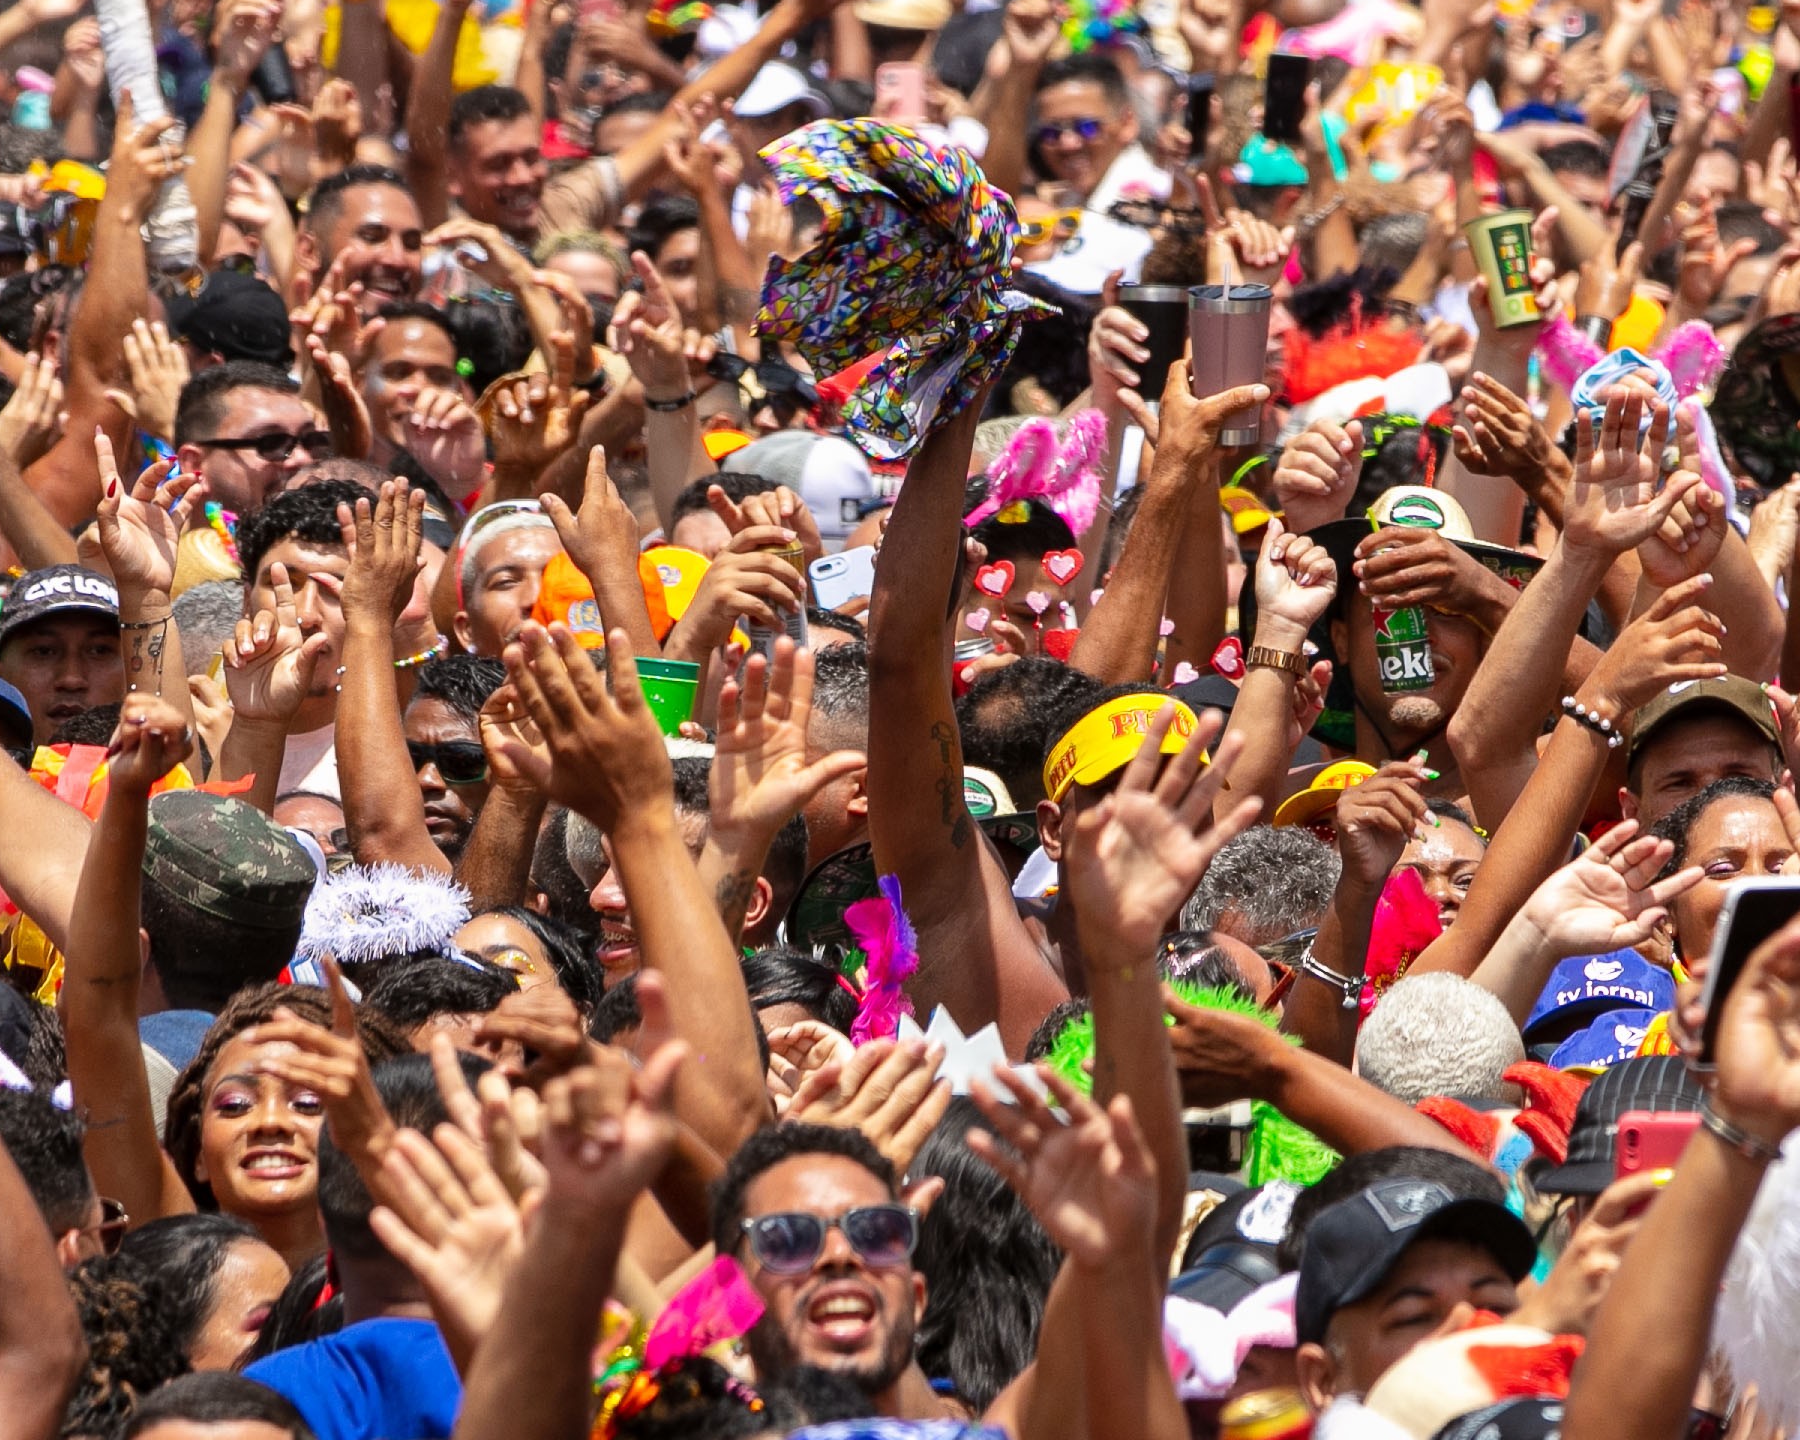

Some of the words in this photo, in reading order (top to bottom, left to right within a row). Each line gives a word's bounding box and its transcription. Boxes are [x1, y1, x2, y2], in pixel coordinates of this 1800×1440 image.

[24, 575, 119, 608] CYCLON
[1109, 709, 1192, 740] PIÚ
[1556, 988, 1581, 1006] tv
[1585, 980, 1654, 1007] jornal
